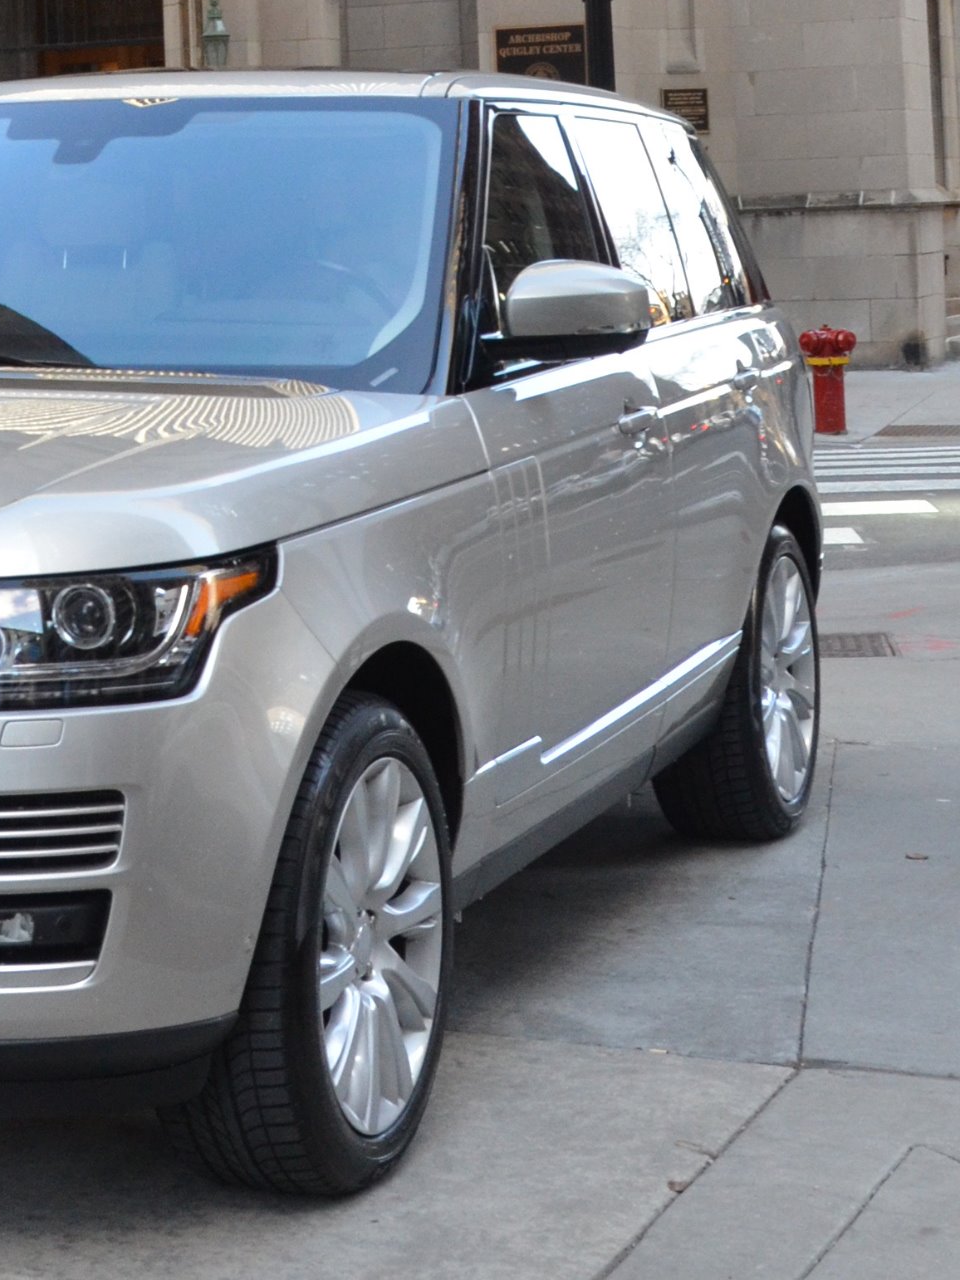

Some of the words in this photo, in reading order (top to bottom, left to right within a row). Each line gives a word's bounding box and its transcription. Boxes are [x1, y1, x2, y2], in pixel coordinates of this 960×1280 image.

[508, 32, 571, 44] ARCHBISHOP
[499, 45, 541, 57] QUIGLEY
[543, 43, 582, 54] CENTER
